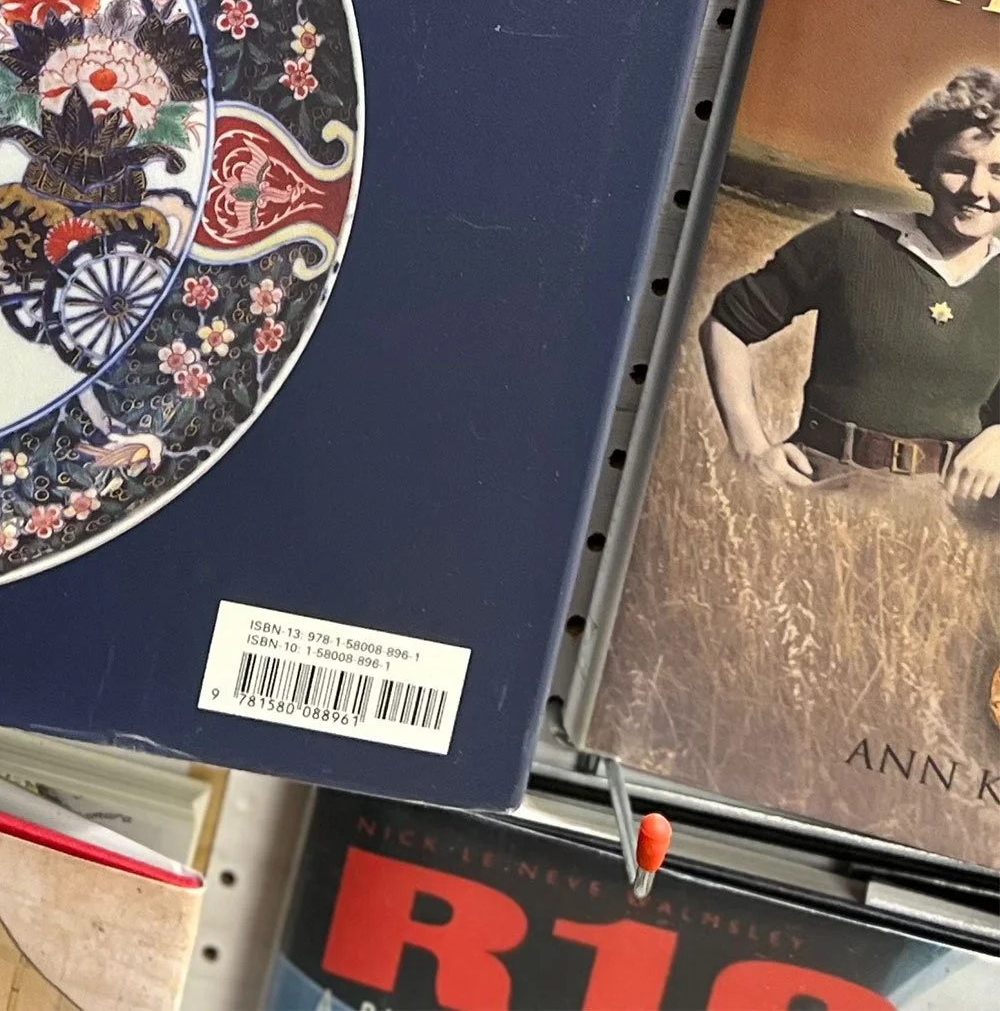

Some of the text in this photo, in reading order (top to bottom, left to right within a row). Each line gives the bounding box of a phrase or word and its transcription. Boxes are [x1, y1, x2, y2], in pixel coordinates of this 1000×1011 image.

[247, 634, 391, 672] ISBN-10: 1-58008-896-1
[250, 620, 421, 663] ISBN-13: 978-1-58008-896-1
[211, 688, 359, 727] 9 781580 088961
[845, 738, 958, 791] ANN
